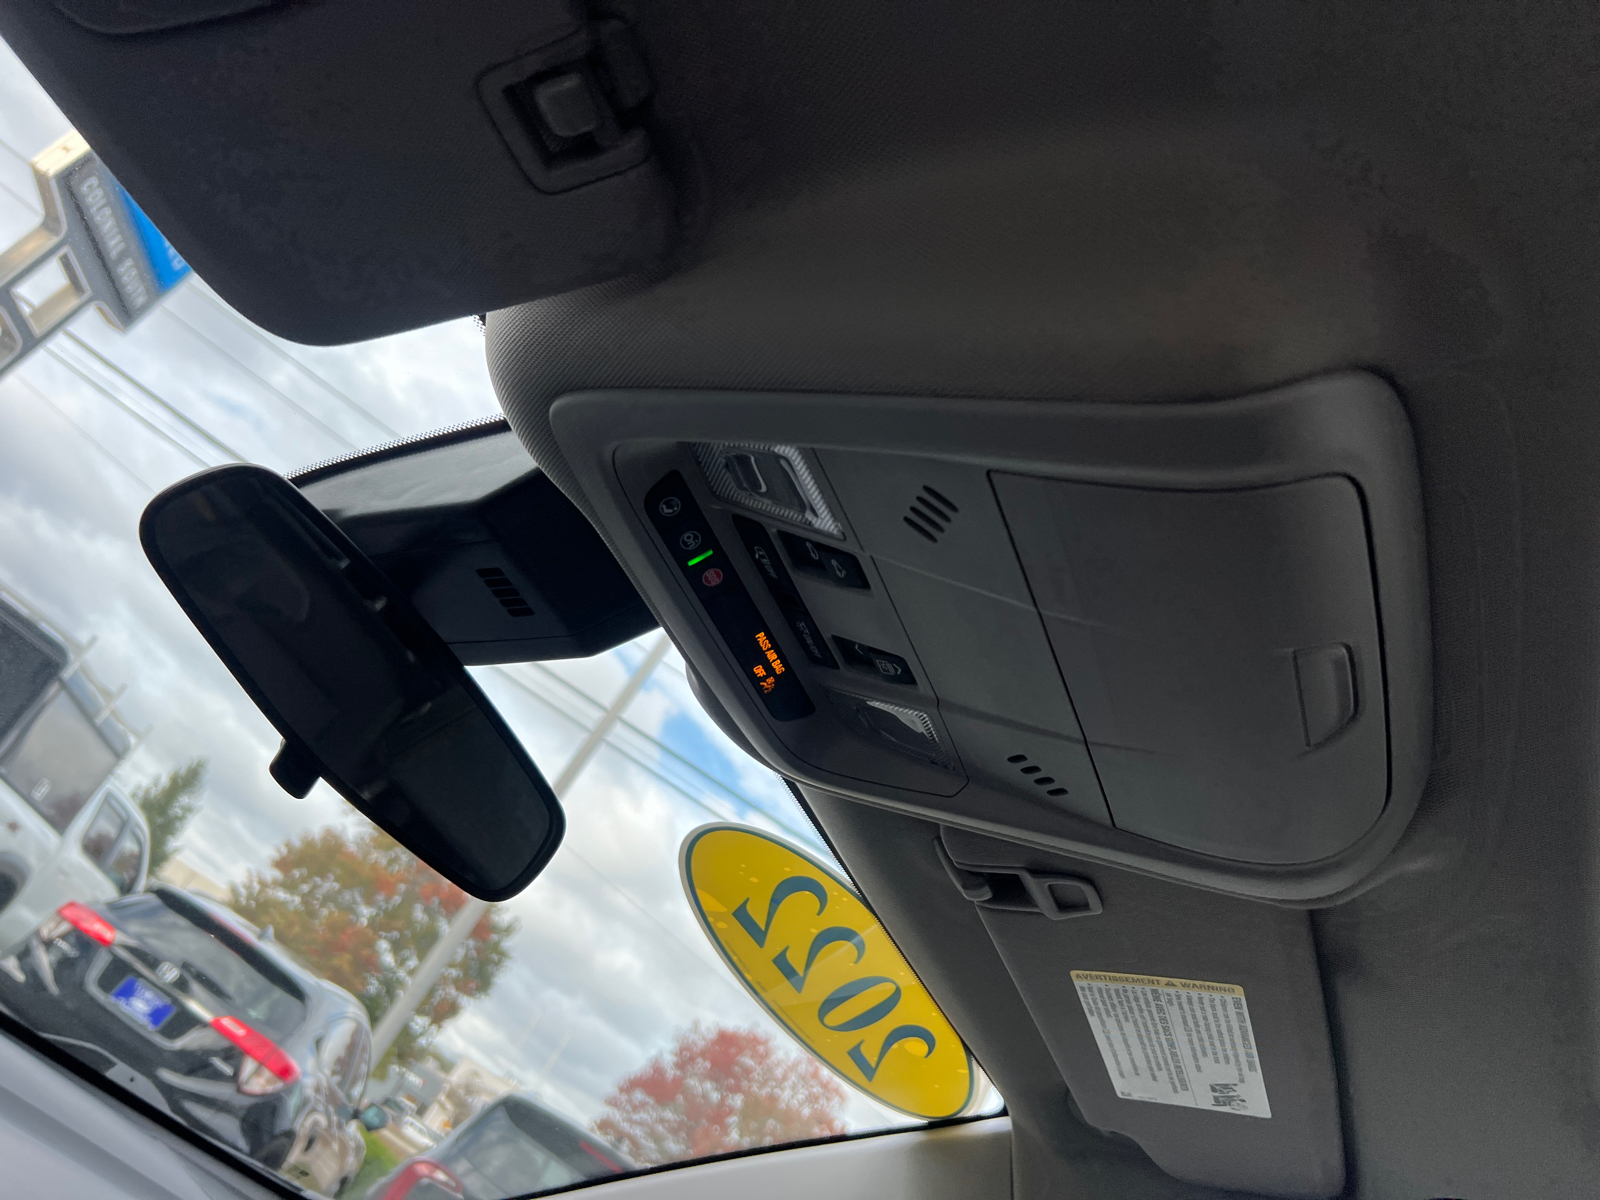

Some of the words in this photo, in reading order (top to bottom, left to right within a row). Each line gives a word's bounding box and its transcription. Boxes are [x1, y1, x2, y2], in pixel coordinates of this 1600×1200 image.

[80, 176, 127, 258] COLONIAL
[116, 258, 148, 307] SOUTH
[704, 569, 719, 586] SOS
[754, 631, 771, 651] PASS
[763, 648, 778, 662] AIR
[752, 664, 766, 679] OFF
[770, 659, 785, 675] BAG
[1075, 973, 1162, 986] AVERTISSEMENT
[1180, 981, 1235, 993] WARNING
